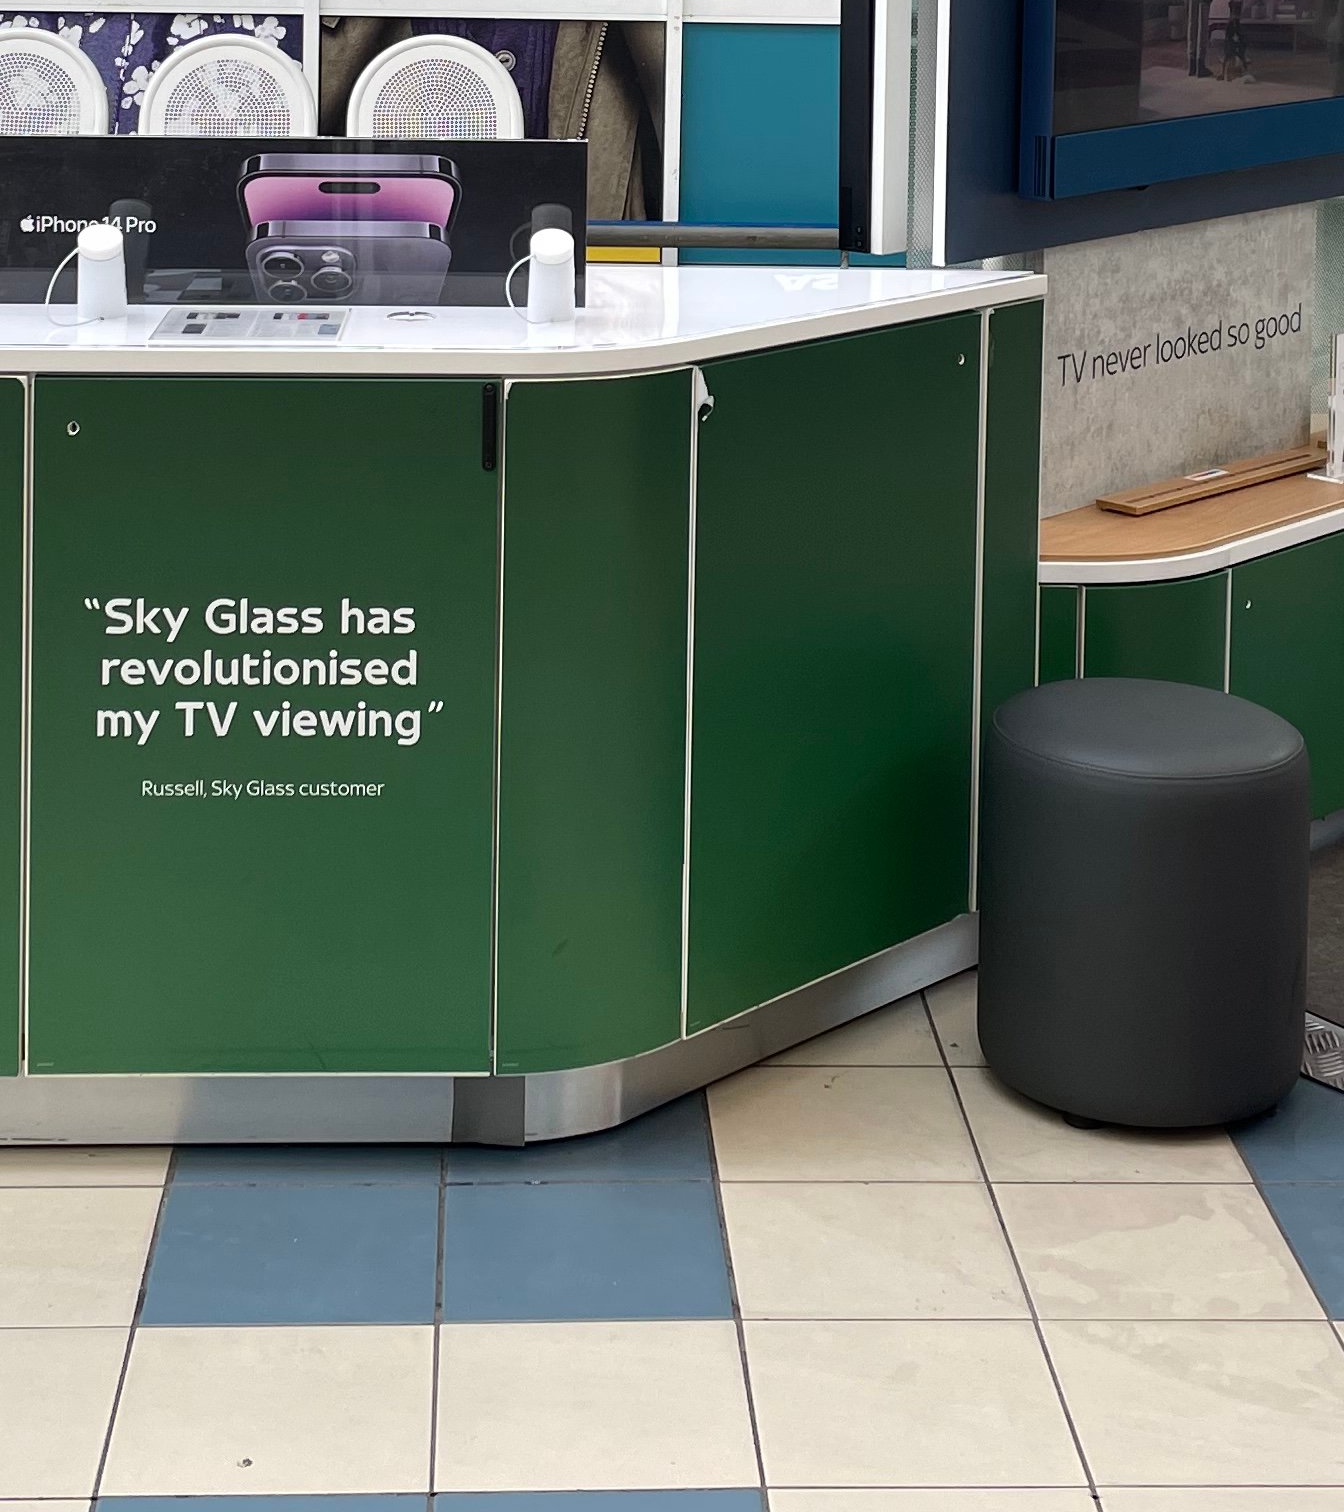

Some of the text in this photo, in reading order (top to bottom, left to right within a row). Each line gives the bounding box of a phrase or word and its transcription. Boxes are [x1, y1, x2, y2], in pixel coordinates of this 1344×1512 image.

[126, 217, 156, 233] Pro
[1058, 304, 1303, 386] TV never looked so good
[205, 598, 324, 635] Glass
[341, 598, 416, 635] has
[101, 649, 418, 686] revolutionised
[96, 709, 160, 745] my
[174, 701, 238, 737] TV
[141, 780, 385, 800] Russell, Sky Glass customer
